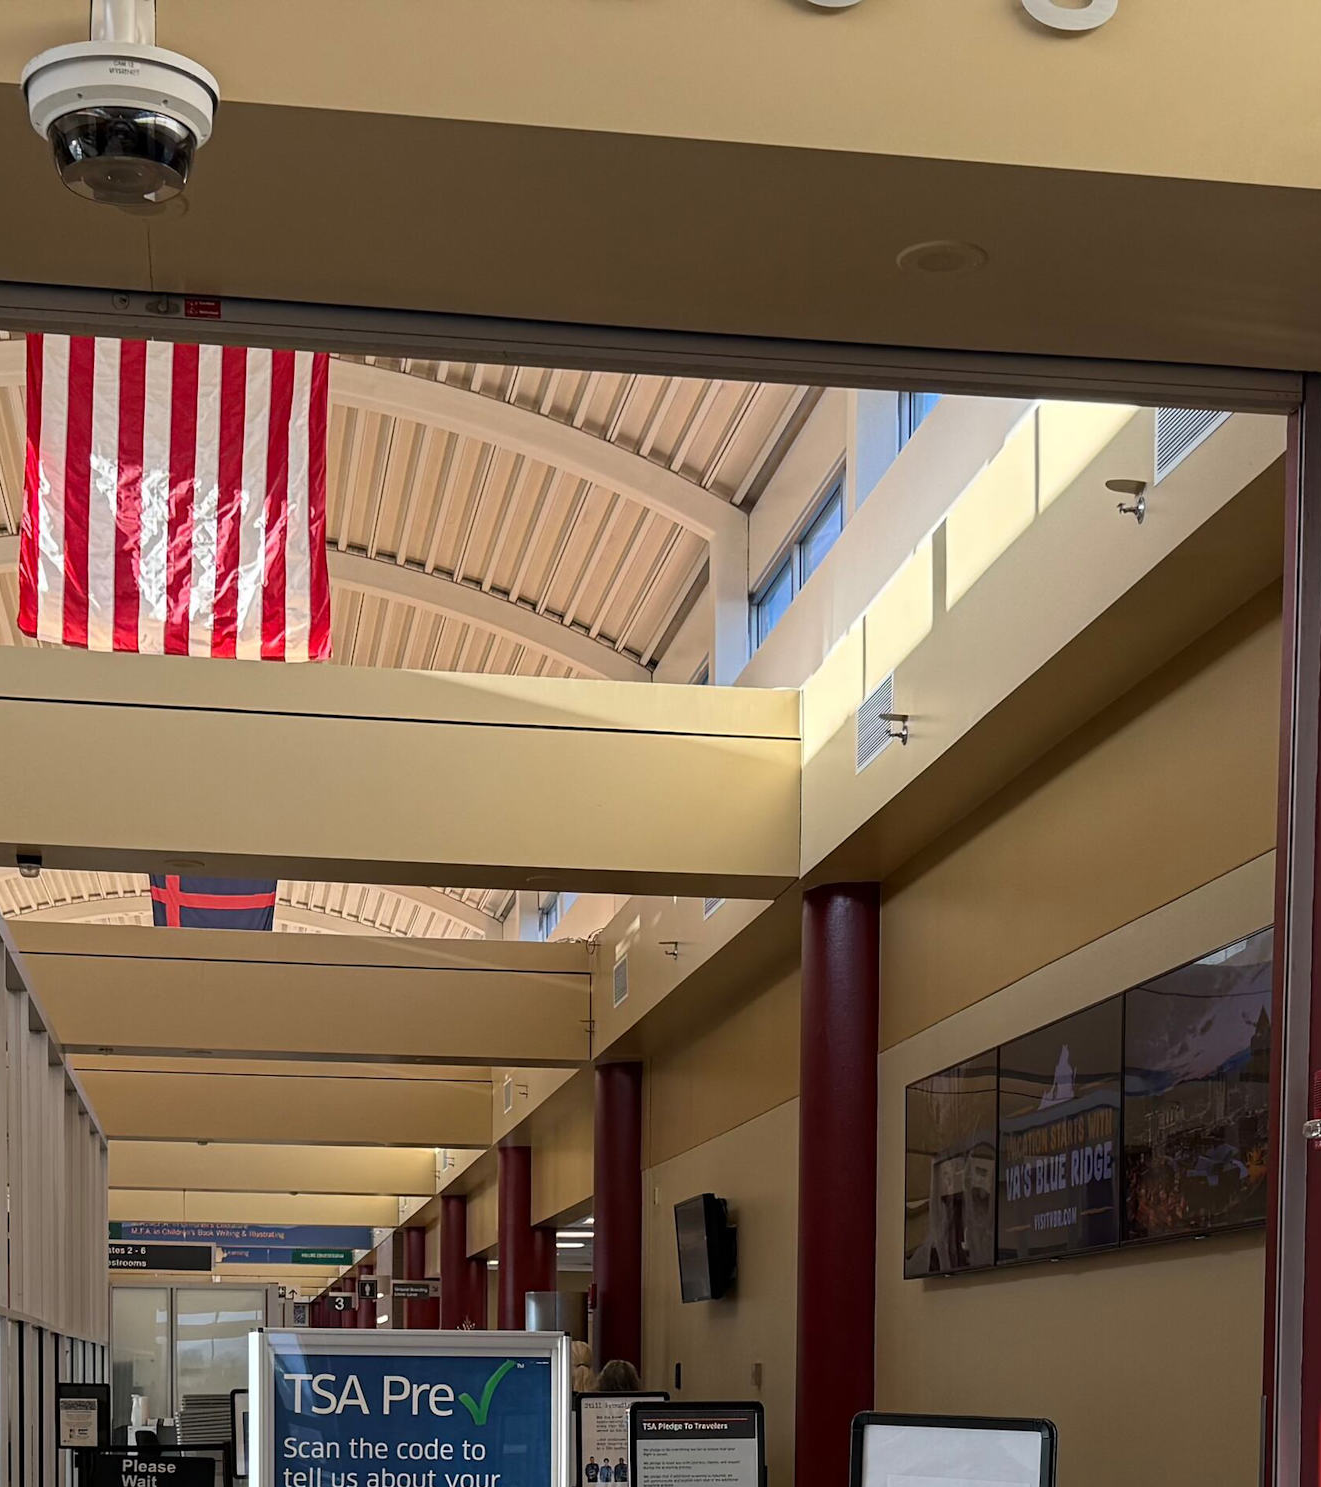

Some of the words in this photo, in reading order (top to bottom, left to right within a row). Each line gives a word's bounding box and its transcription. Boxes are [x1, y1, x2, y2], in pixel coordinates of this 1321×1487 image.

[1051, 1119, 1084, 1149] STARTS
[1088, 1107, 1113, 1139] WITH
[1006, 1162, 1031, 1201] VA'S
[1036, 1153, 1067, 1194] BLUE
[1071, 1141, 1112, 1186] RIDGE
[216, 1230, 240, 1239] Writing
[109, 1247, 125, 1255] ates
[127, 1247, 134, 1255] 2
[334, 1297, 345, 1311] 3
[284, 1374, 370, 1415] TSA
[383, 1375, 454, 1416] Pre
[658, 1422, 683, 1431] Pledge
[684, 1422, 693, 1430] To
[694, 1422, 728, 1430] Travelers
[283, 1437, 340, 1459] Scan
[349, 1438, 388, 1460] the
[396, 1438, 453, 1460] code
[462, 1440, 486, 1461] to
[122, 1459, 176, 1473] Please
[121, 1475, 157, 1487] Wait
[283, 1467, 321, 1487] tell
